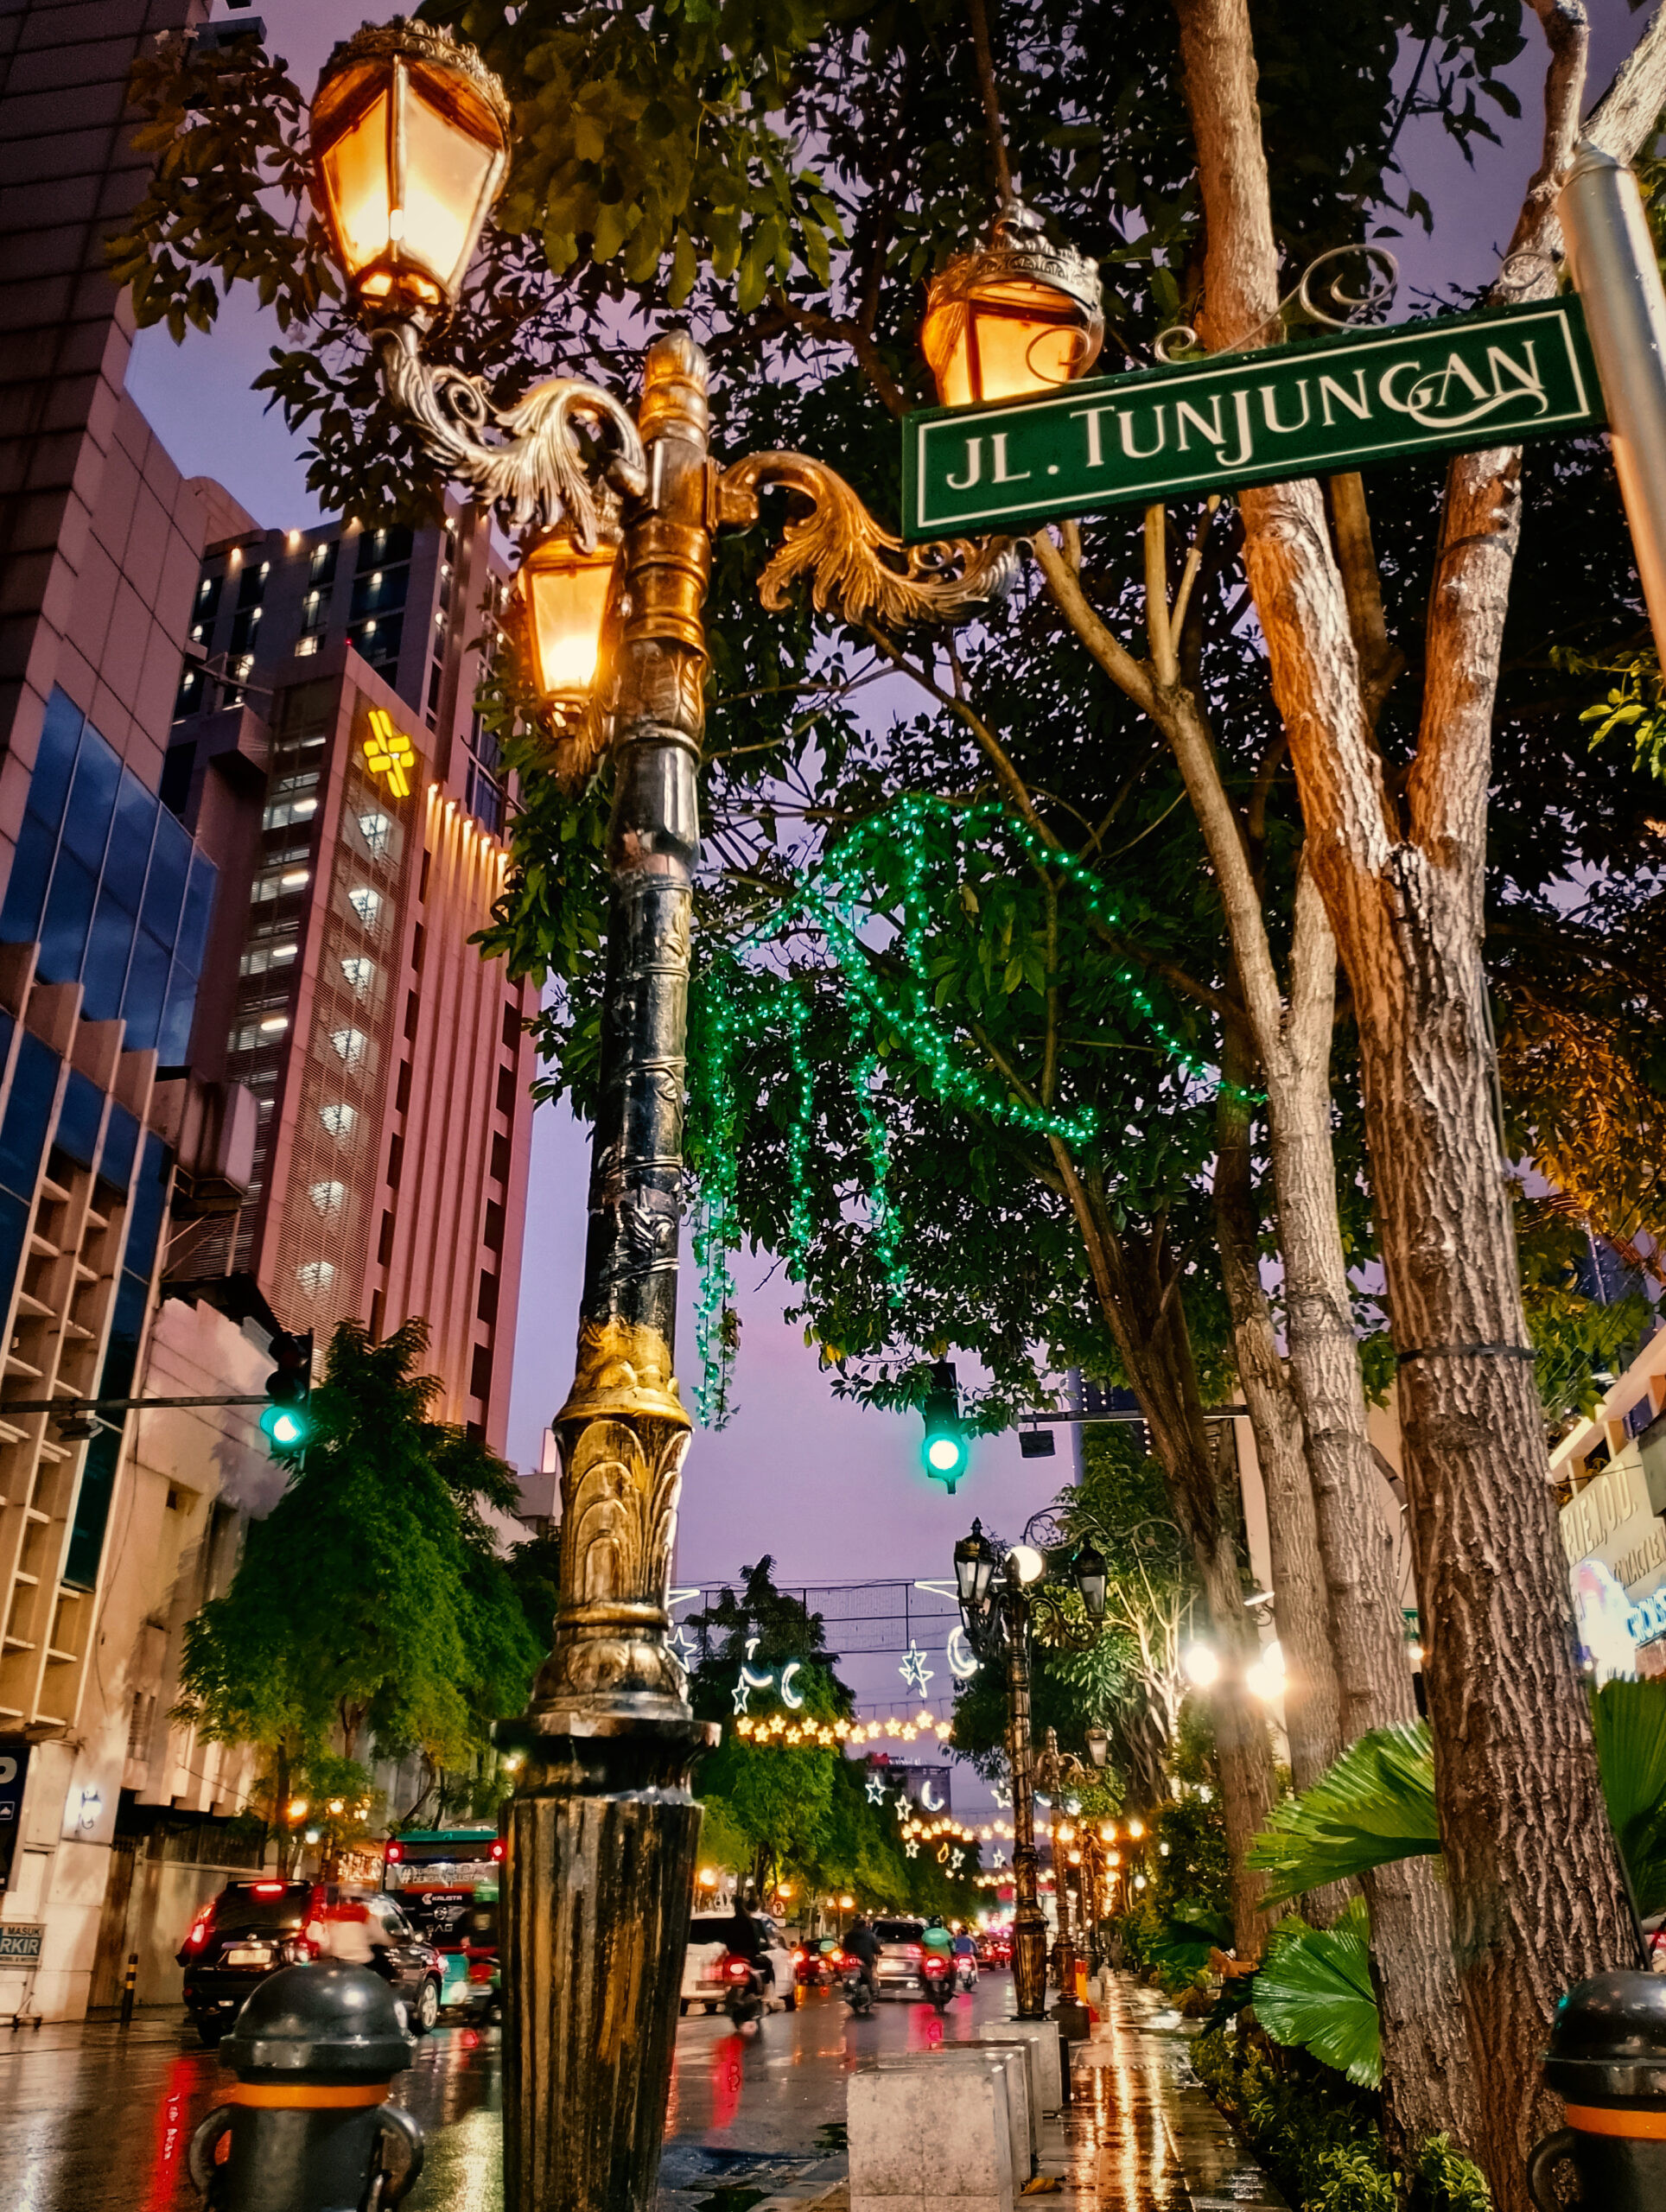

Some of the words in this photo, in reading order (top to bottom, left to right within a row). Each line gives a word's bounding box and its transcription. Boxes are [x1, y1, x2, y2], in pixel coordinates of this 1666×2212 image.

[946, 432, 1059, 490] JL.
[1070, 340, 1548, 467] TUNJUNGAN
[8, 1927, 41, 1936] MASUK
[0, 1937, 40, 1955] RKIR
